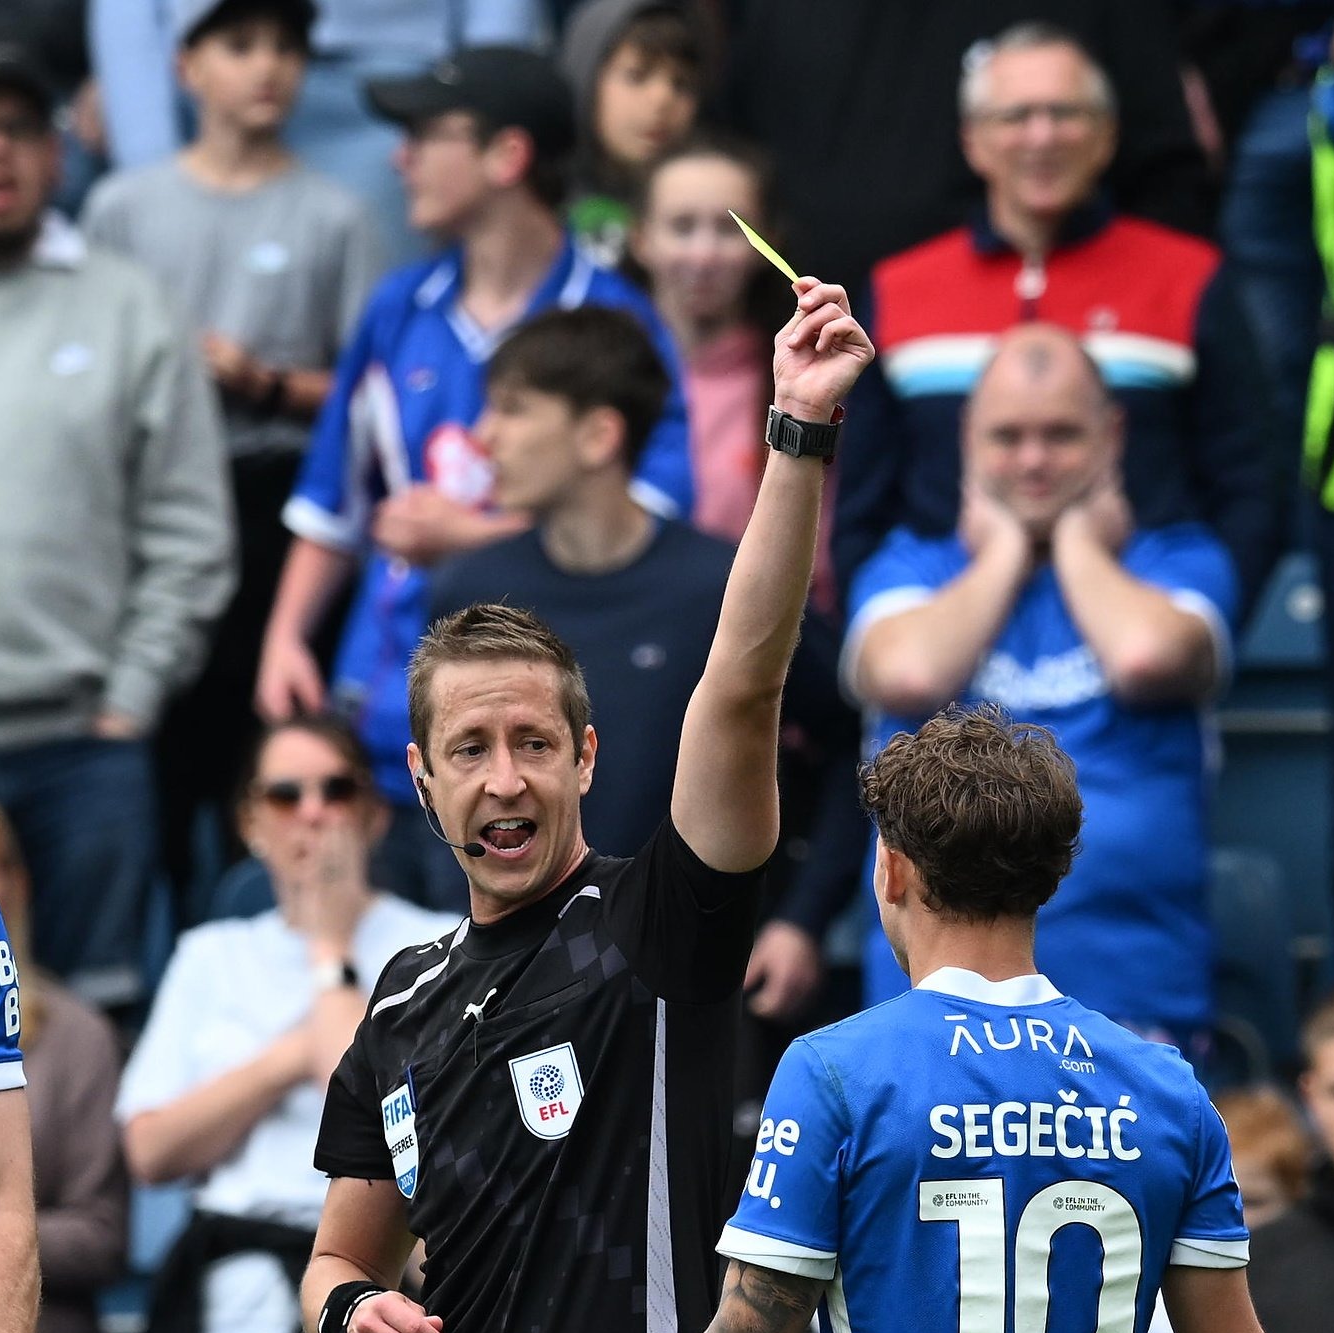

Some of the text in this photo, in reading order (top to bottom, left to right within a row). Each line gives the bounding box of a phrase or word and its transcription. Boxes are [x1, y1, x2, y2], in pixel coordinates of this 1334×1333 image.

[1058, 1058, 1096, 1075] .com
[384, 1093, 412, 1131] FIFA
[539, 1101, 569, 1121] EFL
[929, 1088, 1142, 1161] SEGEČIĆ
[389, 1133, 415, 1159] EFEREE
[756, 1112, 801, 1156] ee
[745, 1158, 781, 1209] u.
